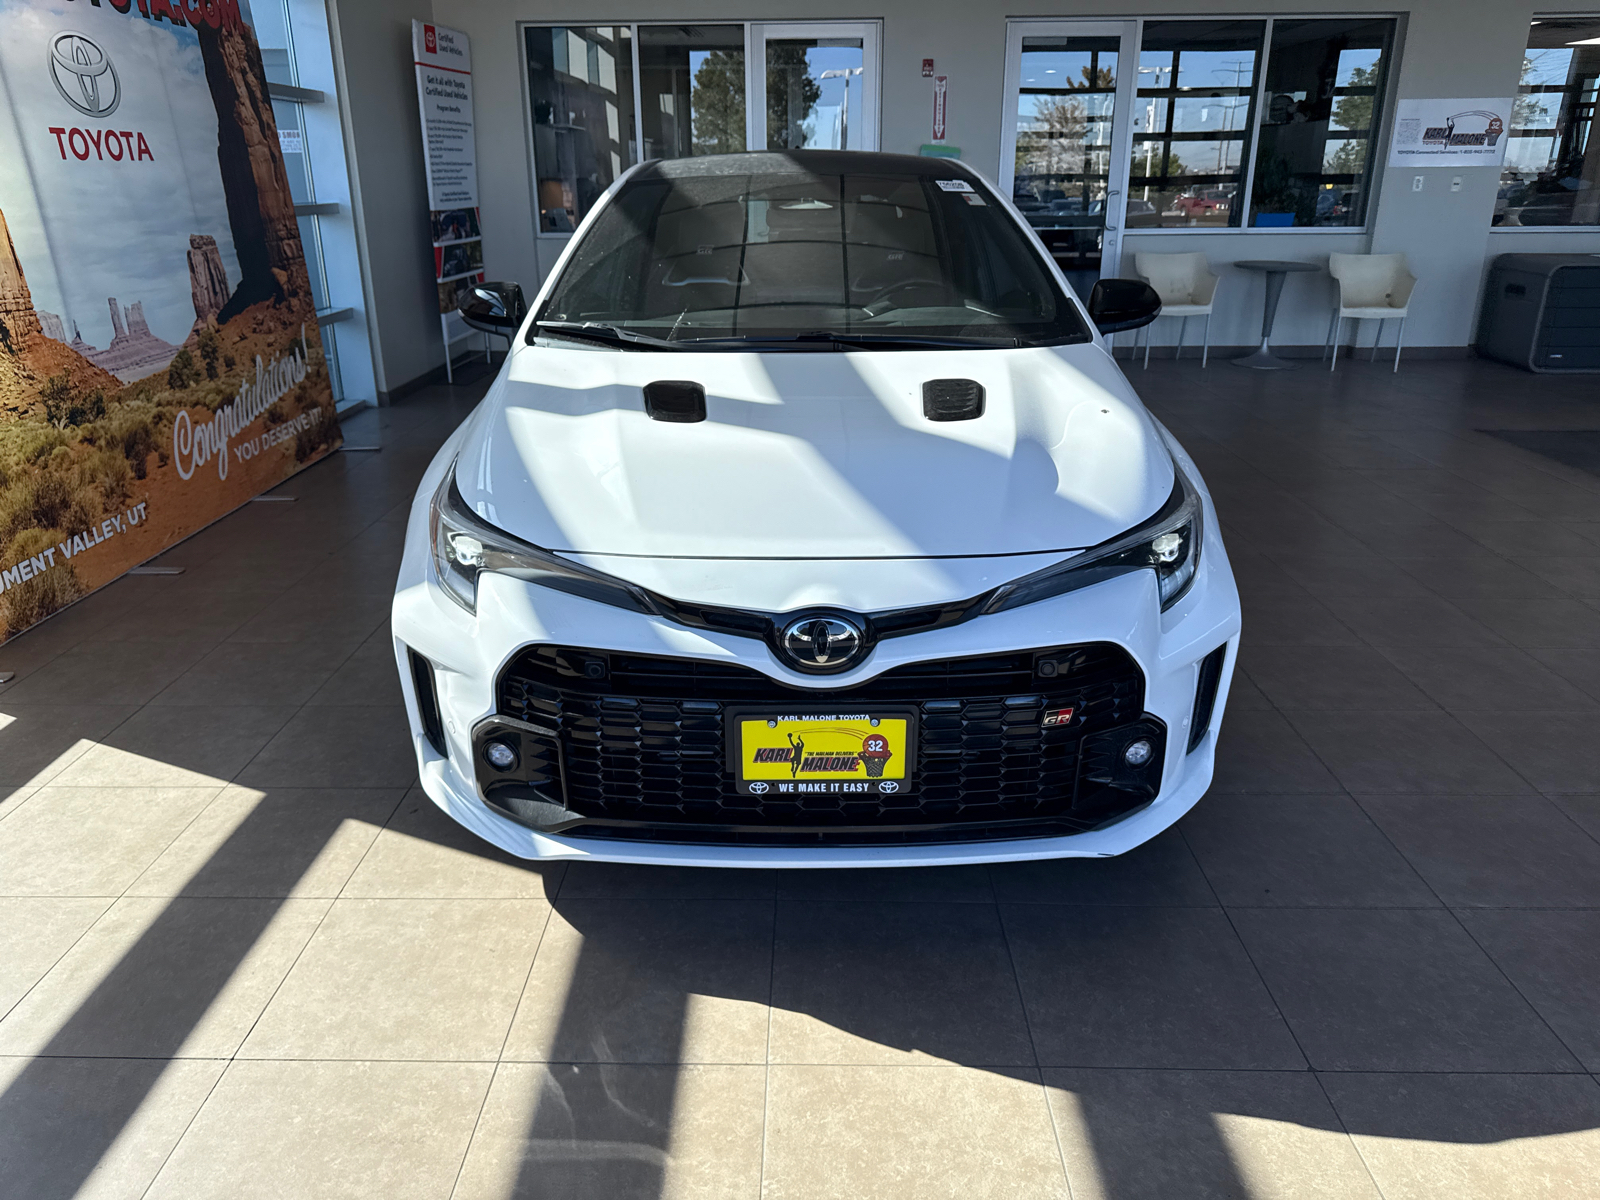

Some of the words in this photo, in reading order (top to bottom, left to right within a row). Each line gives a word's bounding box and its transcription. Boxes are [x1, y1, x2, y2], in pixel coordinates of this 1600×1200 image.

[1491, 121, 1500, 129] 32
[48, 127, 155, 162] TOYOTA
[1422, 127, 1449, 140] KARL
[1448, 133, 1487, 146] MALONE
[173, 322, 312, 481] Congratulations!
[234, 437, 260, 463] YOU
[262, 413, 310, 450] DESERVE
[59, 514, 127, 559] VALLEY,
[127, 502, 147, 525] UT
[1043, 713, 1070, 725] GR
[868, 740, 883, 752] 32
[753, 748, 793, 763] KARL
[800, 756, 860, 772] MALONE
[778, 783, 794, 792] WE
[798, 783, 827, 792] MAKE
[830, 783, 840, 792] IT
[843, 783, 869, 792] EASY
